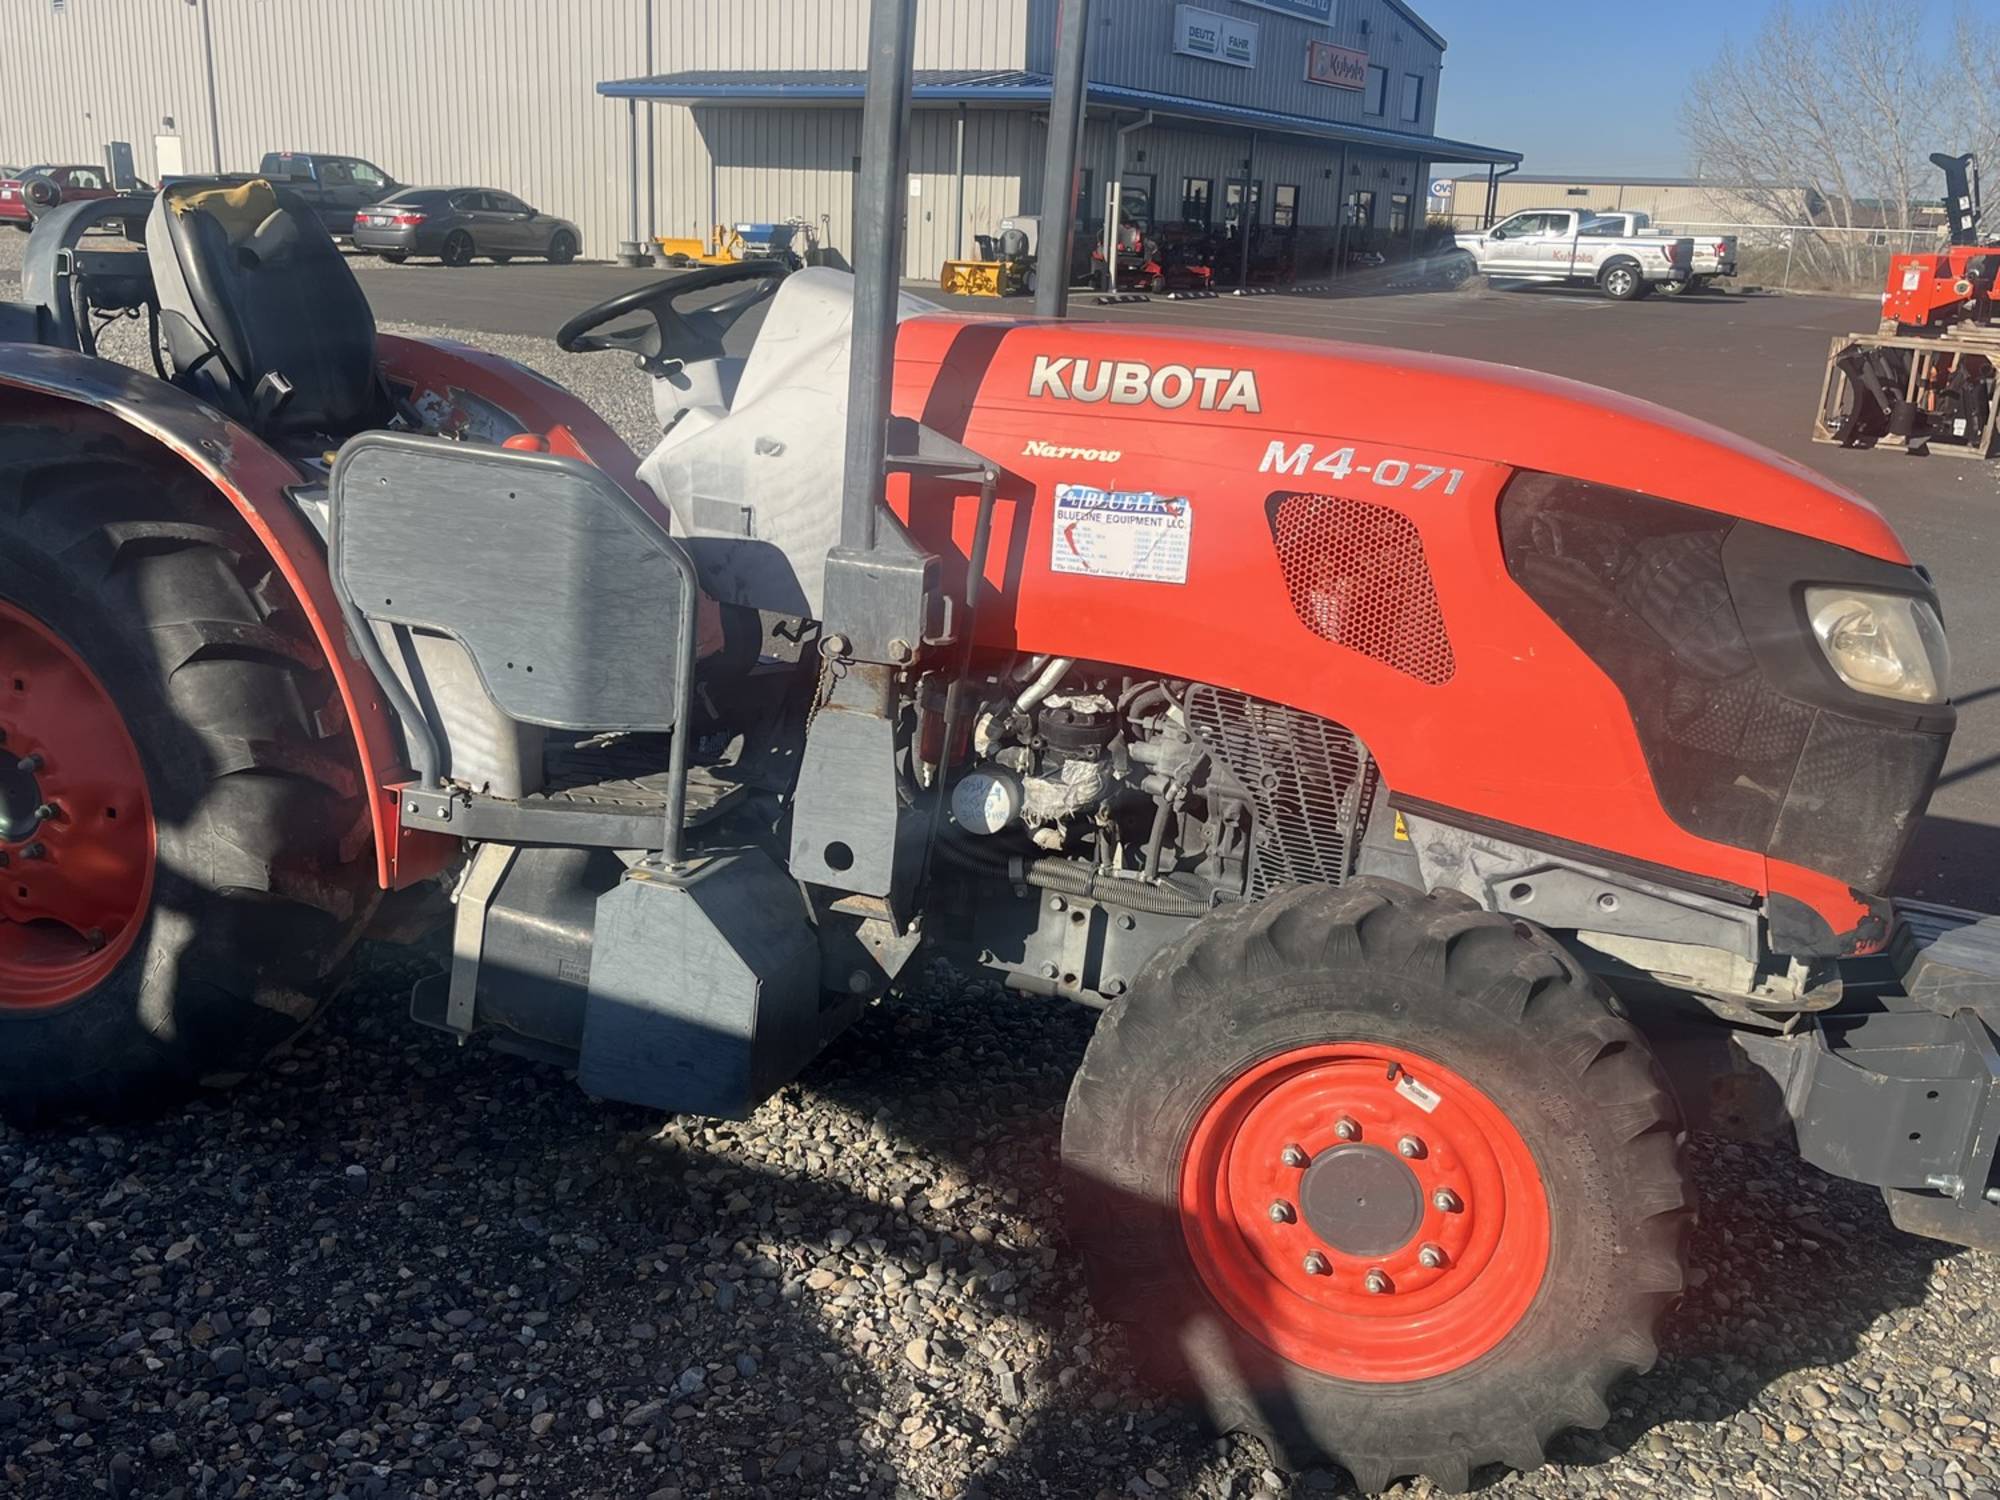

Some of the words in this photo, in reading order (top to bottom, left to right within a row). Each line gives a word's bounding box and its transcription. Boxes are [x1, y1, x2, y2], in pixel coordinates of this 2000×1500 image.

[1188, 26, 1215, 41] DEUTZ
[1228, 35, 1249, 49] FAHR
[1330, 53, 1365, 82] Kubota
[1552, 250, 1593, 264] Kubota
[1028, 355, 1262, 413] KUBOTA
[1022, 440, 1121, 463] Narrow
[1258, 440, 1464, 495] M4-071
[1106, 514, 1162, 527] EQUIPMENT
